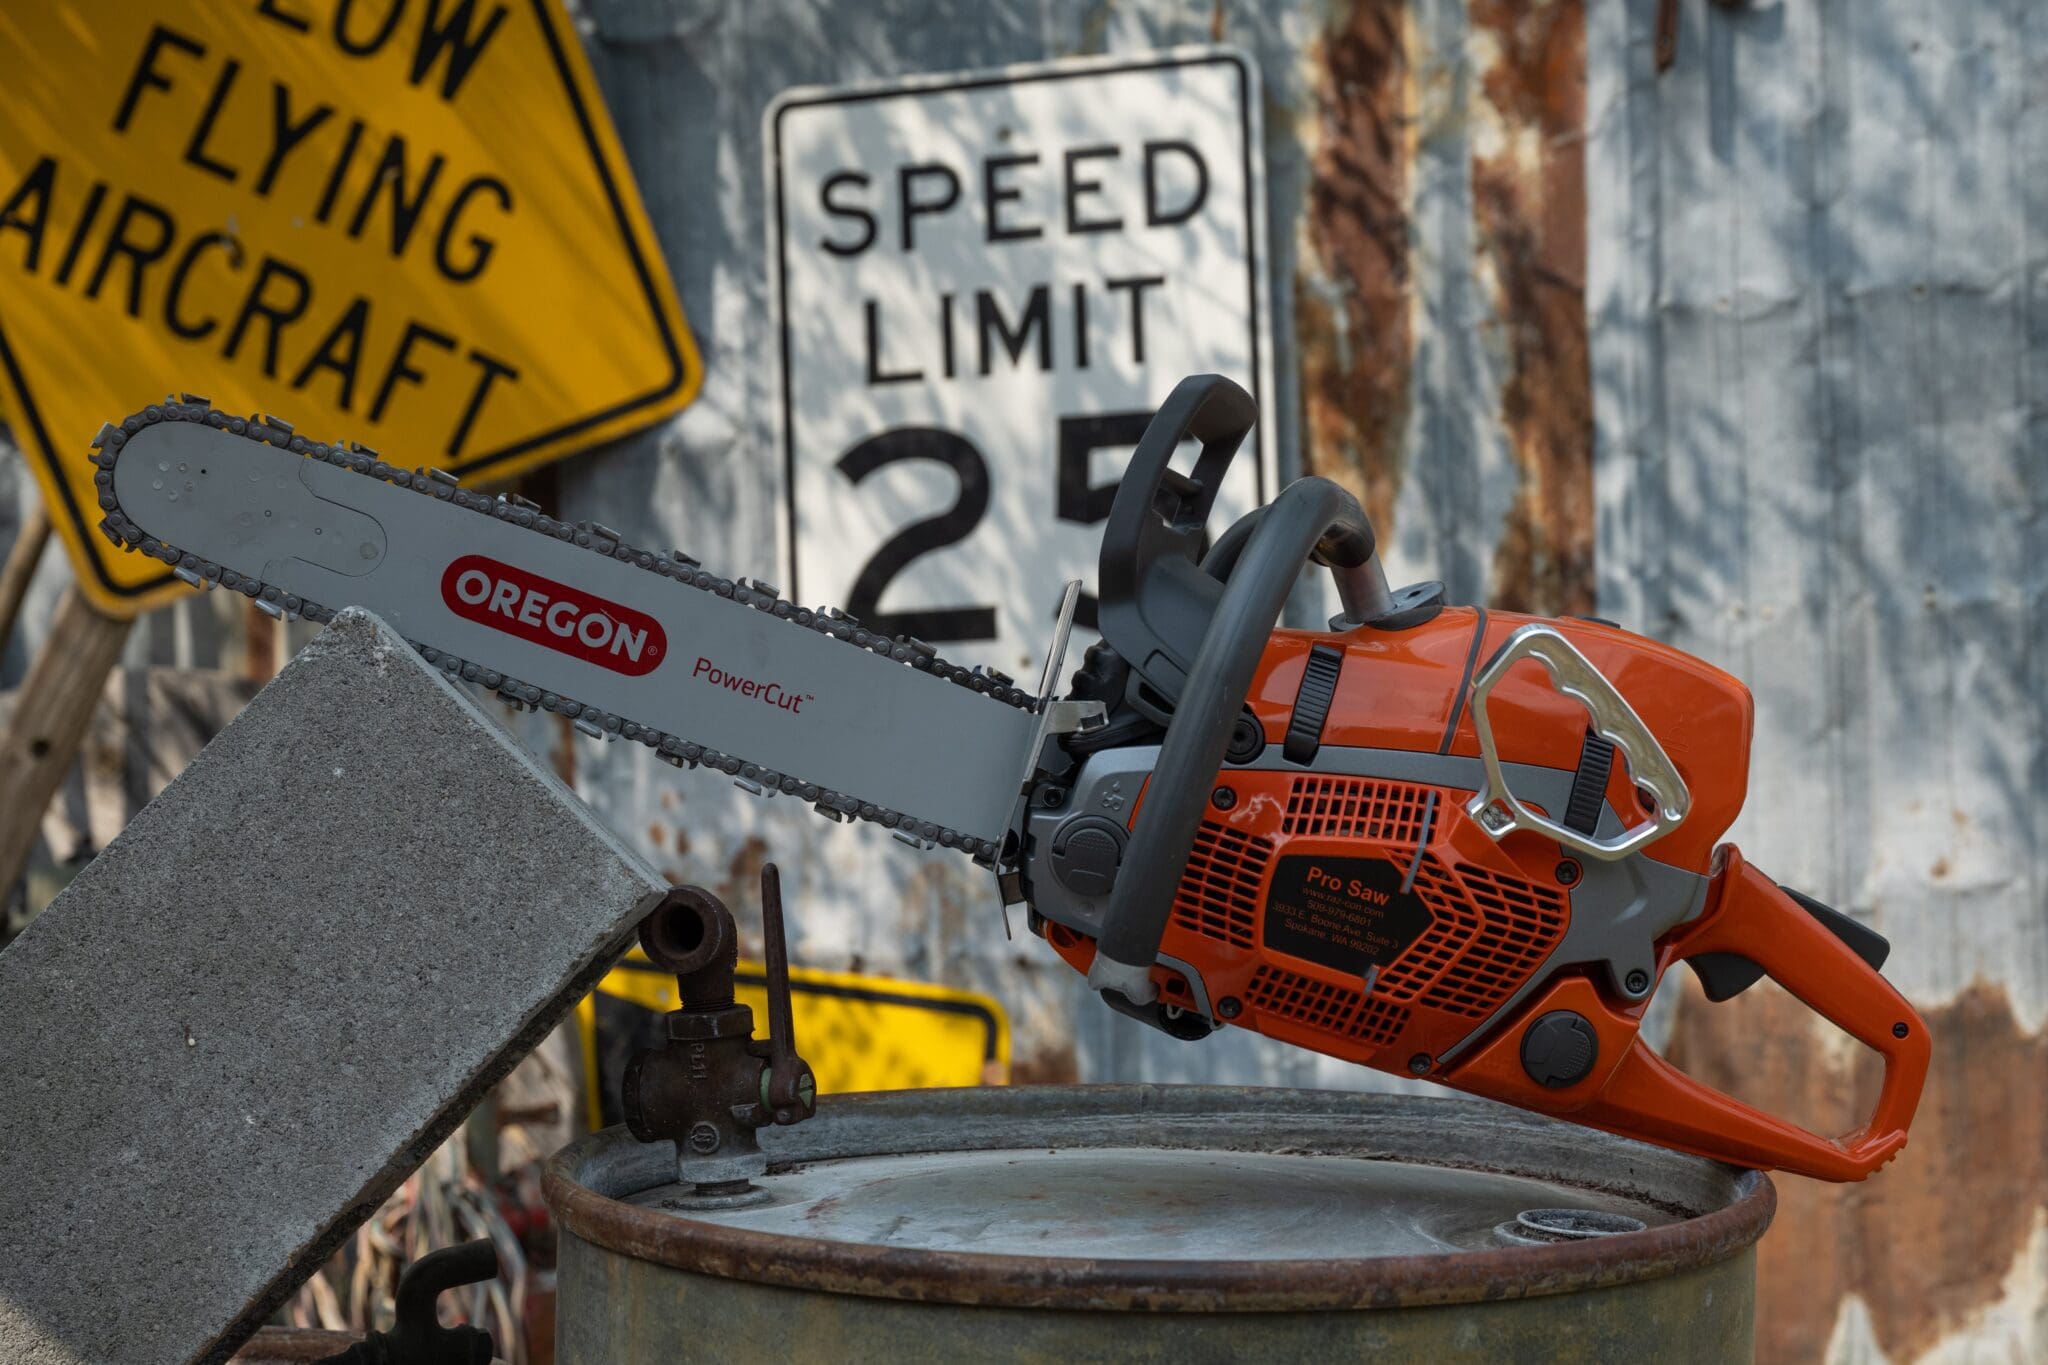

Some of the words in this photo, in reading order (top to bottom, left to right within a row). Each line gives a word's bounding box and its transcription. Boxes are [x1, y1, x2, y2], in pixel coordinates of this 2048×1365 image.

[111, 23, 514, 286] FLYING
[819, 139, 1211, 258] SPEED
[0, 154, 520, 460] AIRCRAFT
[864, 274, 1166, 386] LIMIT
[1306, 866, 1342, 891] Pro
[1347, 879, 1390, 906] Saw
[1311, 914, 1342, 932] Boone
[1367, 932, 1390, 946] Suite
[1332, 934, 1348, 946] WA
